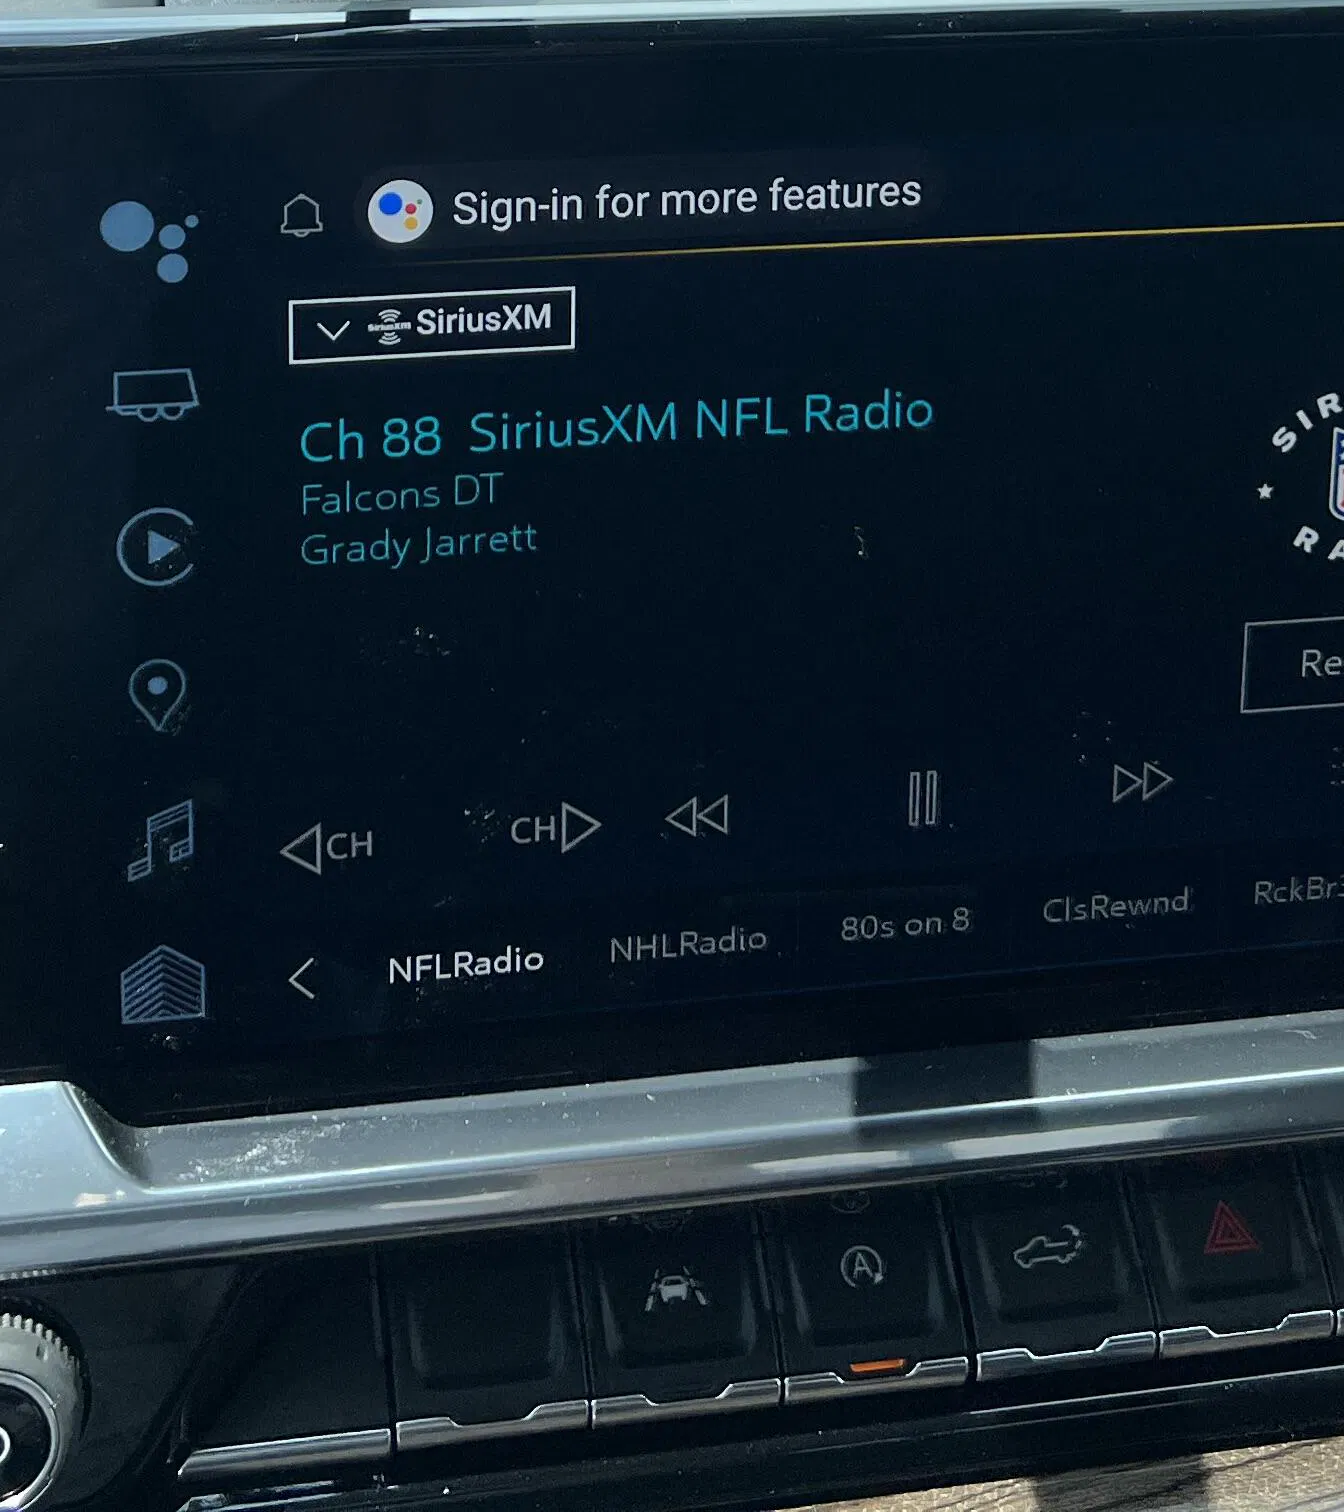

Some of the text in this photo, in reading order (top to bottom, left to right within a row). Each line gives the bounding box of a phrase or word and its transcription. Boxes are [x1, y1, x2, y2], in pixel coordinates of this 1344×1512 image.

[453, 177, 922, 232] Sign-in for more features
[417, 303, 551, 335] SiriusXM
[300, 388, 933, 462] Ch 88 SiriusXM NFL Radio
[302, 472, 504, 516] Falcons DT
[300, 524, 537, 569] Grady Jarrett
[326, 830, 374, 860] CH
[510, 815, 556, 844] CH
[841, 906, 970, 941] 80s on 8
[610, 926, 768, 963] NHLRadio
[389, 944, 544, 984] NFLRadio
